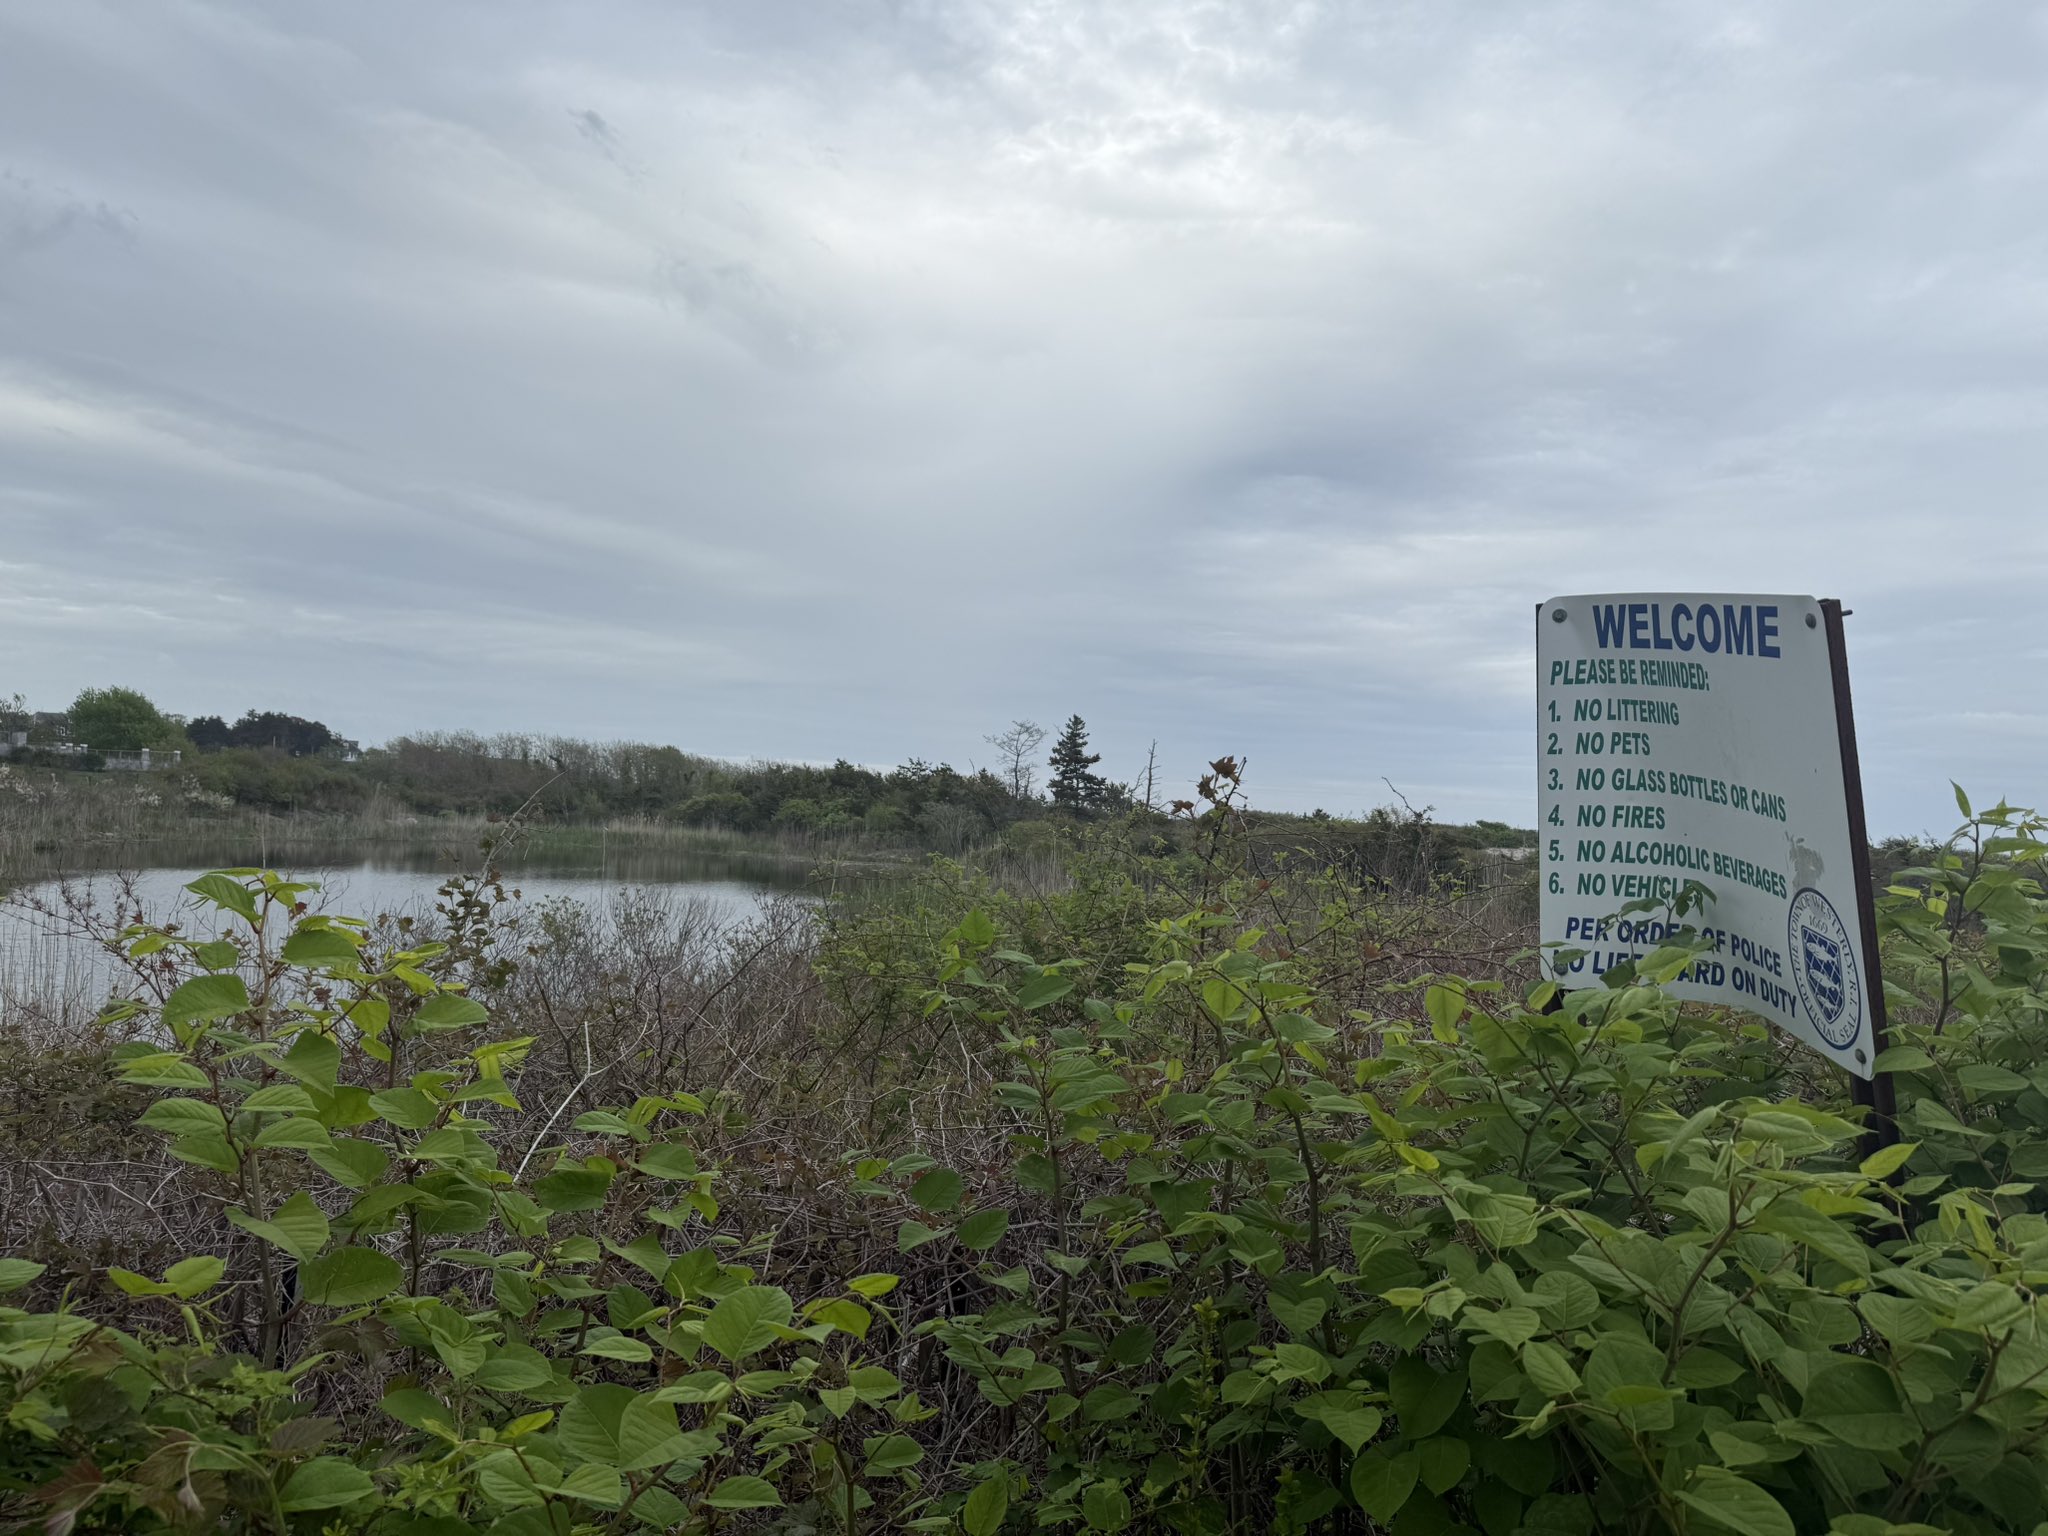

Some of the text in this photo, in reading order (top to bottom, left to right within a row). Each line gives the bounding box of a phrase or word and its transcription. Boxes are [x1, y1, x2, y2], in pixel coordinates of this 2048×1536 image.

[1592, 603, 1781, 659] WELCOME
[1550, 659, 1710, 691] PLEASE BE REMINDED:
[1548, 698, 1680, 726] 1. NO LITTERING
[1547, 732, 1651, 756] 2. NO PETS
[1547, 768, 1787, 823] 3. NO GLASS BOTTLES OR CANS
[1548, 804, 1666, 830] 4. NO FIRES
[1548, 840, 1787, 900] 5. NO ALCOHOLIC BEVERAGES
[1548, 872, 1697, 903] 6. NO VEHICL
[1566, 917, 1609, 941] PER
[1617, 919, 1692, 946] ORDE
[1731, 933, 1782, 978] POLICE
[1732, 966, 1757, 996] ON
[1760, 977, 1797, 1018] DUTY
[1801, 983, 1857, 1043] OFFICIAL SEAL
